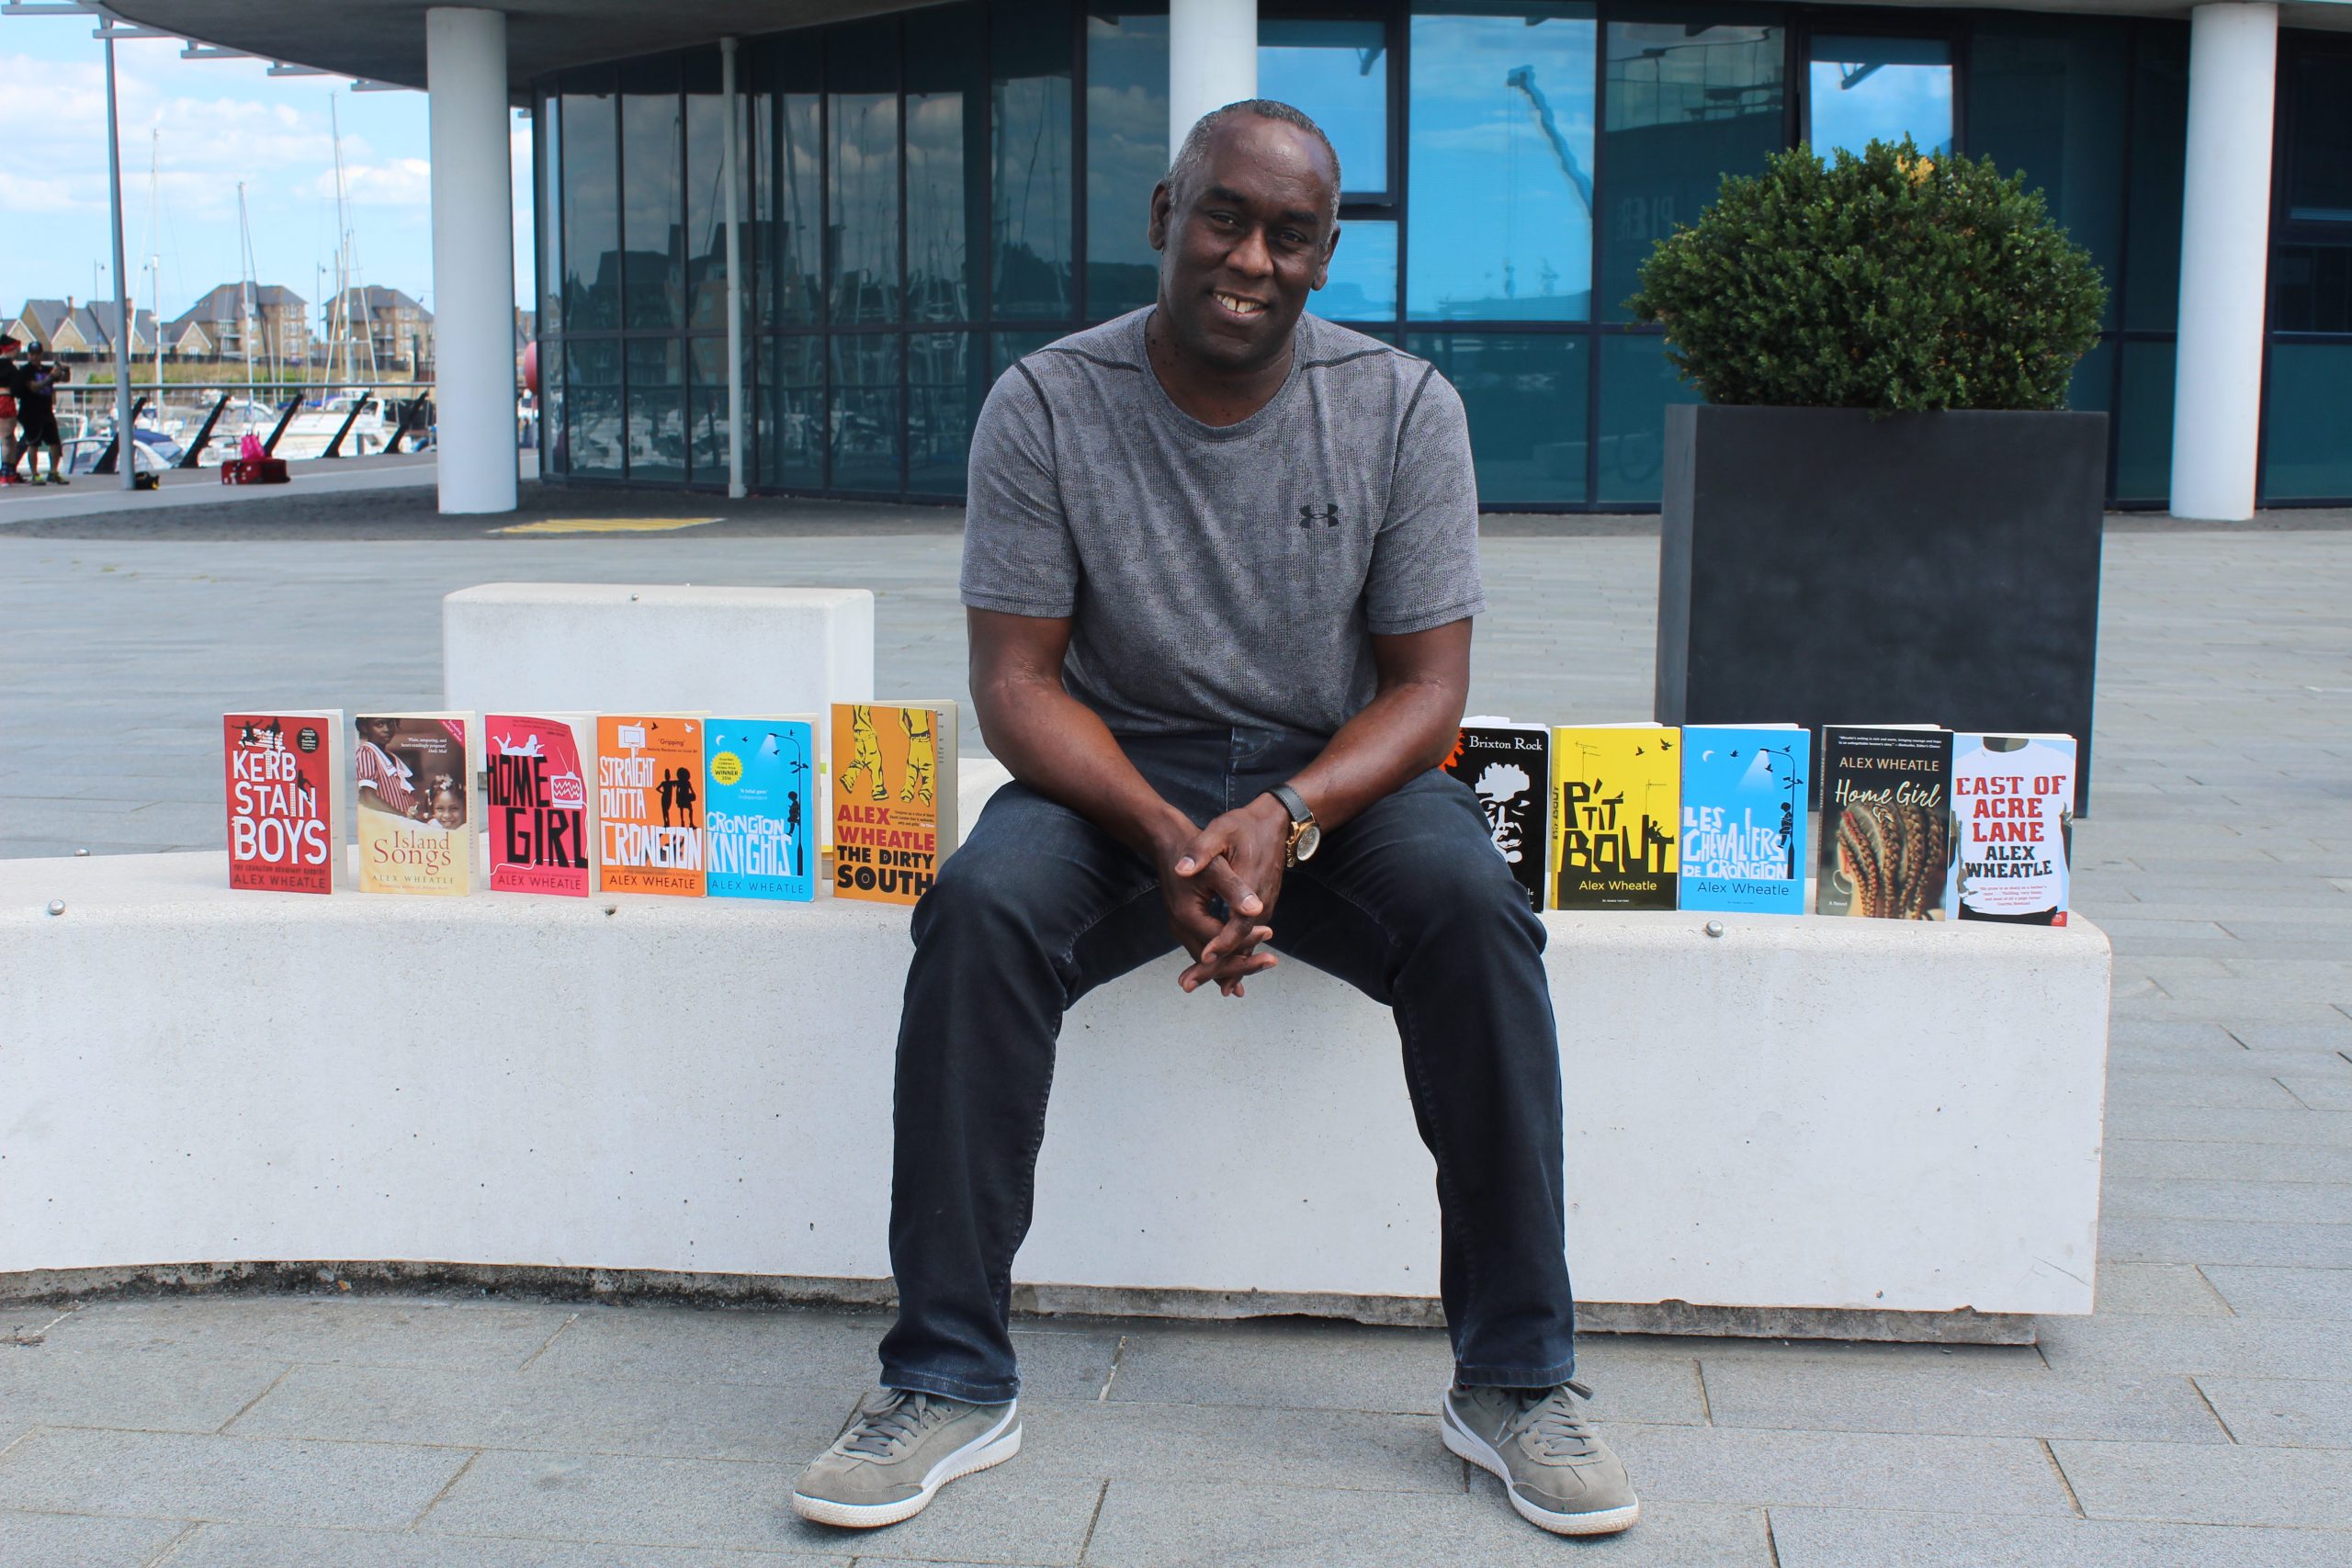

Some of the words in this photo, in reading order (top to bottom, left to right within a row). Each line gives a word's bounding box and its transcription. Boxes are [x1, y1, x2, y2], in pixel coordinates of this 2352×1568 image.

[1469, 735, 1511, 749] Brixton
[1514, 738, 1543, 750] Rock
[232, 749, 297, 783] KERB
[600, 755, 655, 788] STRAIGHT
[1839, 757, 1873, 769] ALEX
[1876, 758, 1939, 772] WHEATLE
[487, 753, 550, 807] HOME
[1956, 776, 2024, 795] EAST
[2033, 775, 2067, 795] OF
[234, 781, 317, 818] STAIN
[600, 788, 647, 818] OUTTA
[1835, 779, 1893, 807] Home
[1896, 781, 1941, 807] Girl
[838, 805, 891, 825] ALEX
[1683, 806, 1725, 831] LES
[1973, 797, 2042, 818] ACRE
[707, 811, 785, 835] CRONGTON
[1973, 822, 2044, 842] LANE
[232, 816, 327, 864] BOYS
[394, 830, 449, 850] Island
[506, 807, 588, 869] GIRL
[601, 820, 702, 871] CRONGTON
[838, 826, 934, 852] WHEATLE
[1560, 815, 1674, 873] BOUT
[1683, 808, 1786, 863] CHEVALIERS
[374, 839, 451, 875] Songs
[707, 832, 792, 878] KNIGHTS
[837, 845, 871, 863] THE
[879, 849, 934, 869] DIRTY
[1985, 846, 2035, 861] ALEX
[233, 874, 265, 885] ALEX
[269, 875, 325, 888] WHEATLE
[404, 875, 454, 885] WHEATLE
[837, 864, 934, 896] SOUTH
[1682, 864, 1702, 877] DE
[1706, 860, 1788, 880] CRONGTON
[1965, 860, 2052, 878] WHEATLE
[498, 875, 524, 886] ALEX
[529, 876, 581, 890] WHEATLE
[610, 874, 638, 886] ALEX
[642, 875, 695, 889] WHEATLE
[712, 880, 741, 890] ALEX
[749, 882, 804, 894] WHEATLE
[1579, 881, 1604, 890] Alex
[1608, 881, 1657, 891] Wheatle
[1697, 882, 1726, 893] Alex
[1732, 884, 1790, 896] Wheatle
